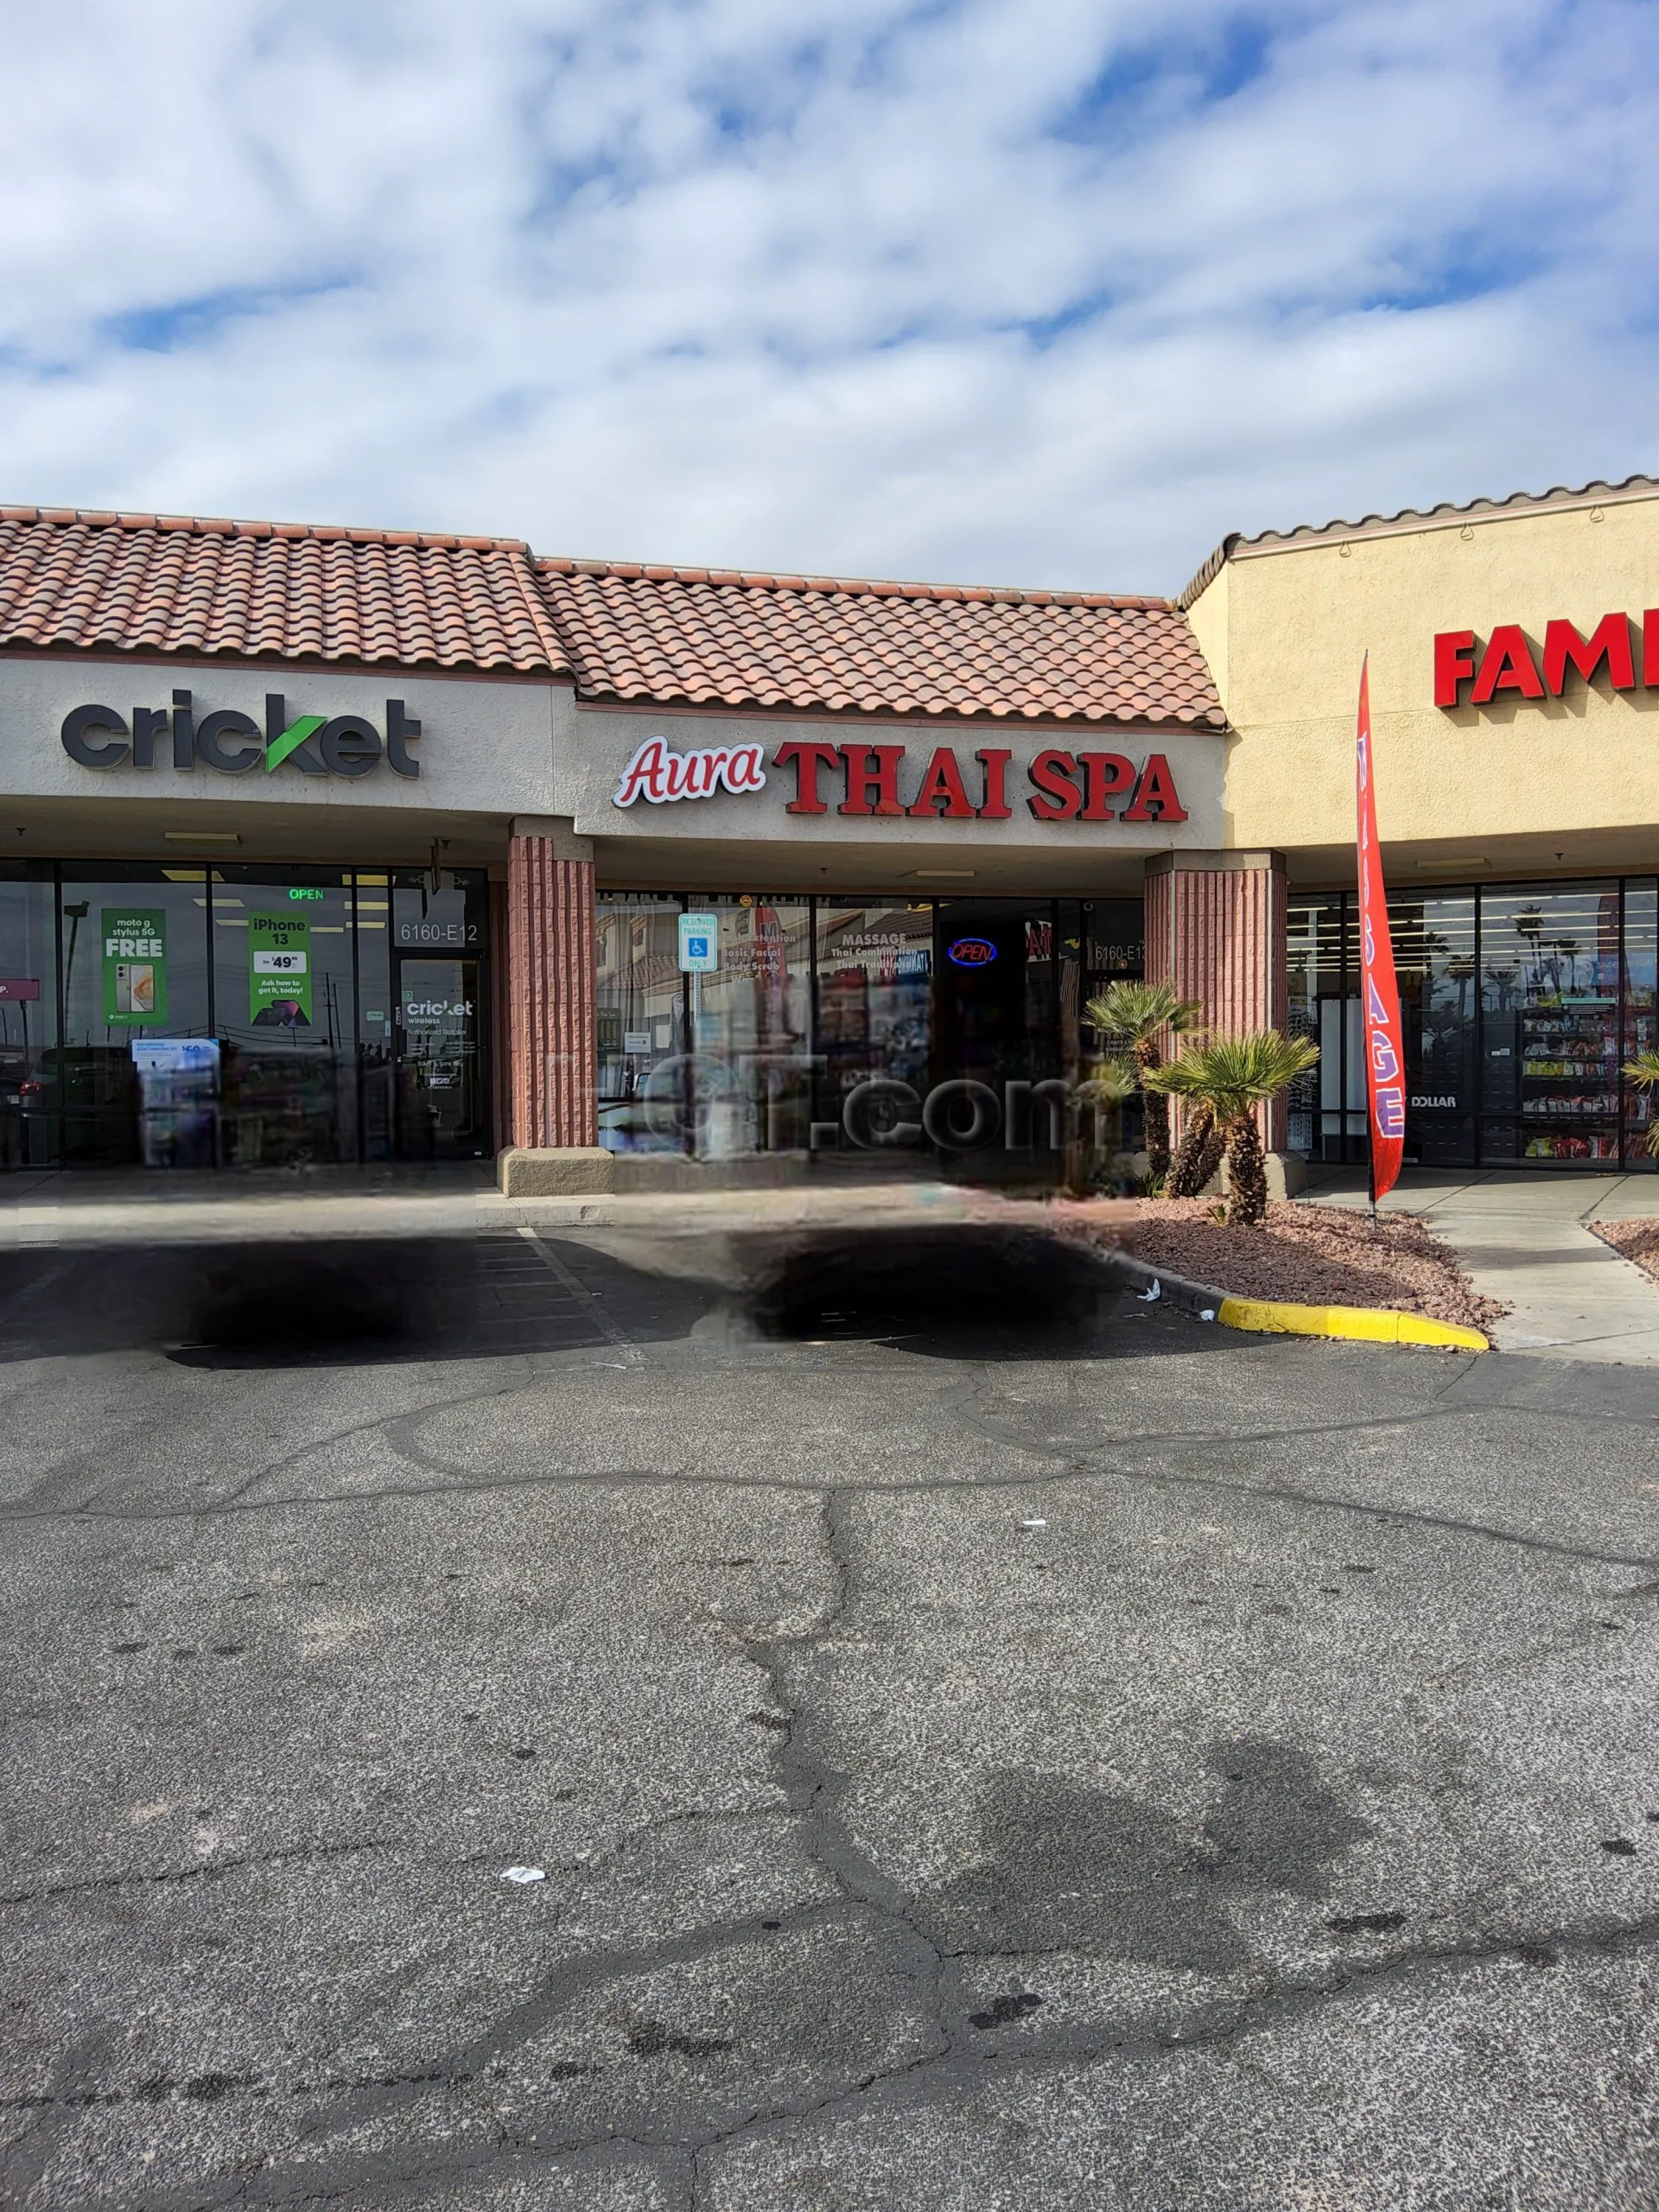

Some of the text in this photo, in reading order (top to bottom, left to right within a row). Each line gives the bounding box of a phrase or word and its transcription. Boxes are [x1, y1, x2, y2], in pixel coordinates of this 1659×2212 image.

[60, 689, 422, 779] cricket
[616, 738, 1188, 822] Aura THAI SPA
[289, 889, 324, 899] OPEN
[254, 918, 305, 931] iPhone
[112, 928, 139, 938] stylus
[401, 924, 477, 941] 6160-E12
[272, 934, 289, 944] 13
[842, 934, 906, 945] MASSAGE
[106, 938, 162, 957] FREE
[751, 948, 780, 957] Facial
[831, 946, 918, 957] Thai Combination
[952, 944, 992, 961] OPEN
[723, 962, 779, 972] Body Scrub
[836, 960, 858, 969] Thai
[407, 1001, 473, 1015] cricket
[1412, 1096, 1456, 1108] DOLLAR
